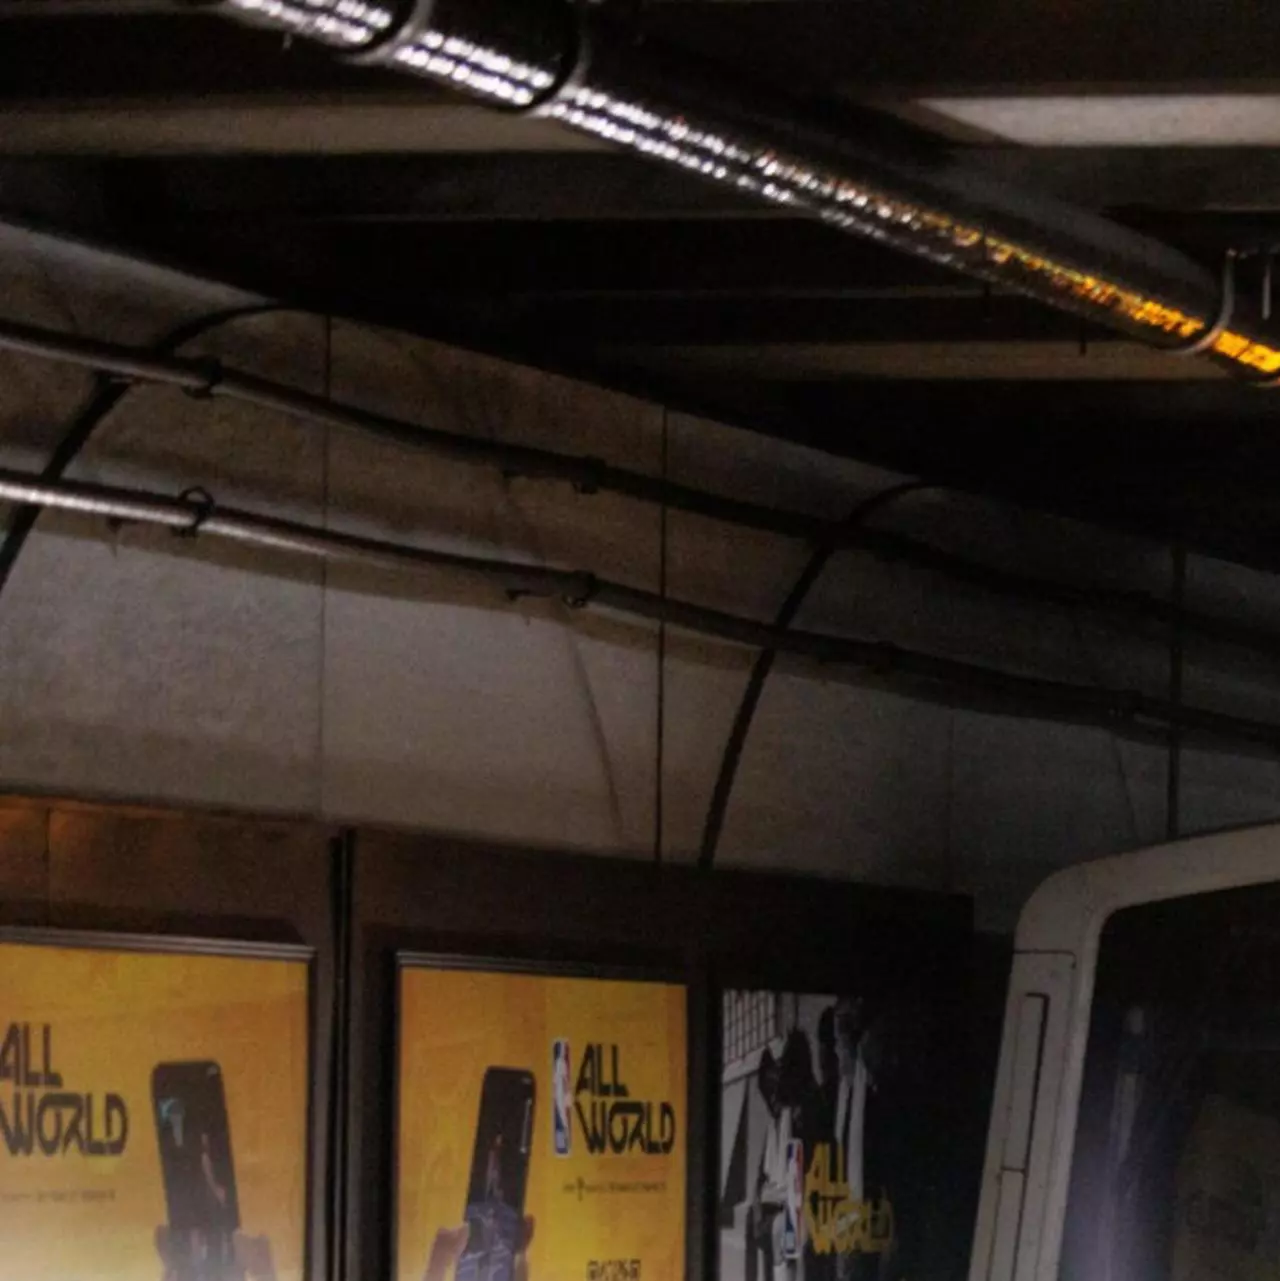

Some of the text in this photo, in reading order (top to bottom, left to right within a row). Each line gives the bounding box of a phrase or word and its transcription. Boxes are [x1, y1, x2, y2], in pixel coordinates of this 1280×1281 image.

[0, 1023, 63, 1087] ALL
[574, 1042, 630, 1097] ALL
[0, 1091, 129, 1156] WORLD
[574, 1100, 676, 1155] WORLD
[805, 1141, 851, 1197] ALL
